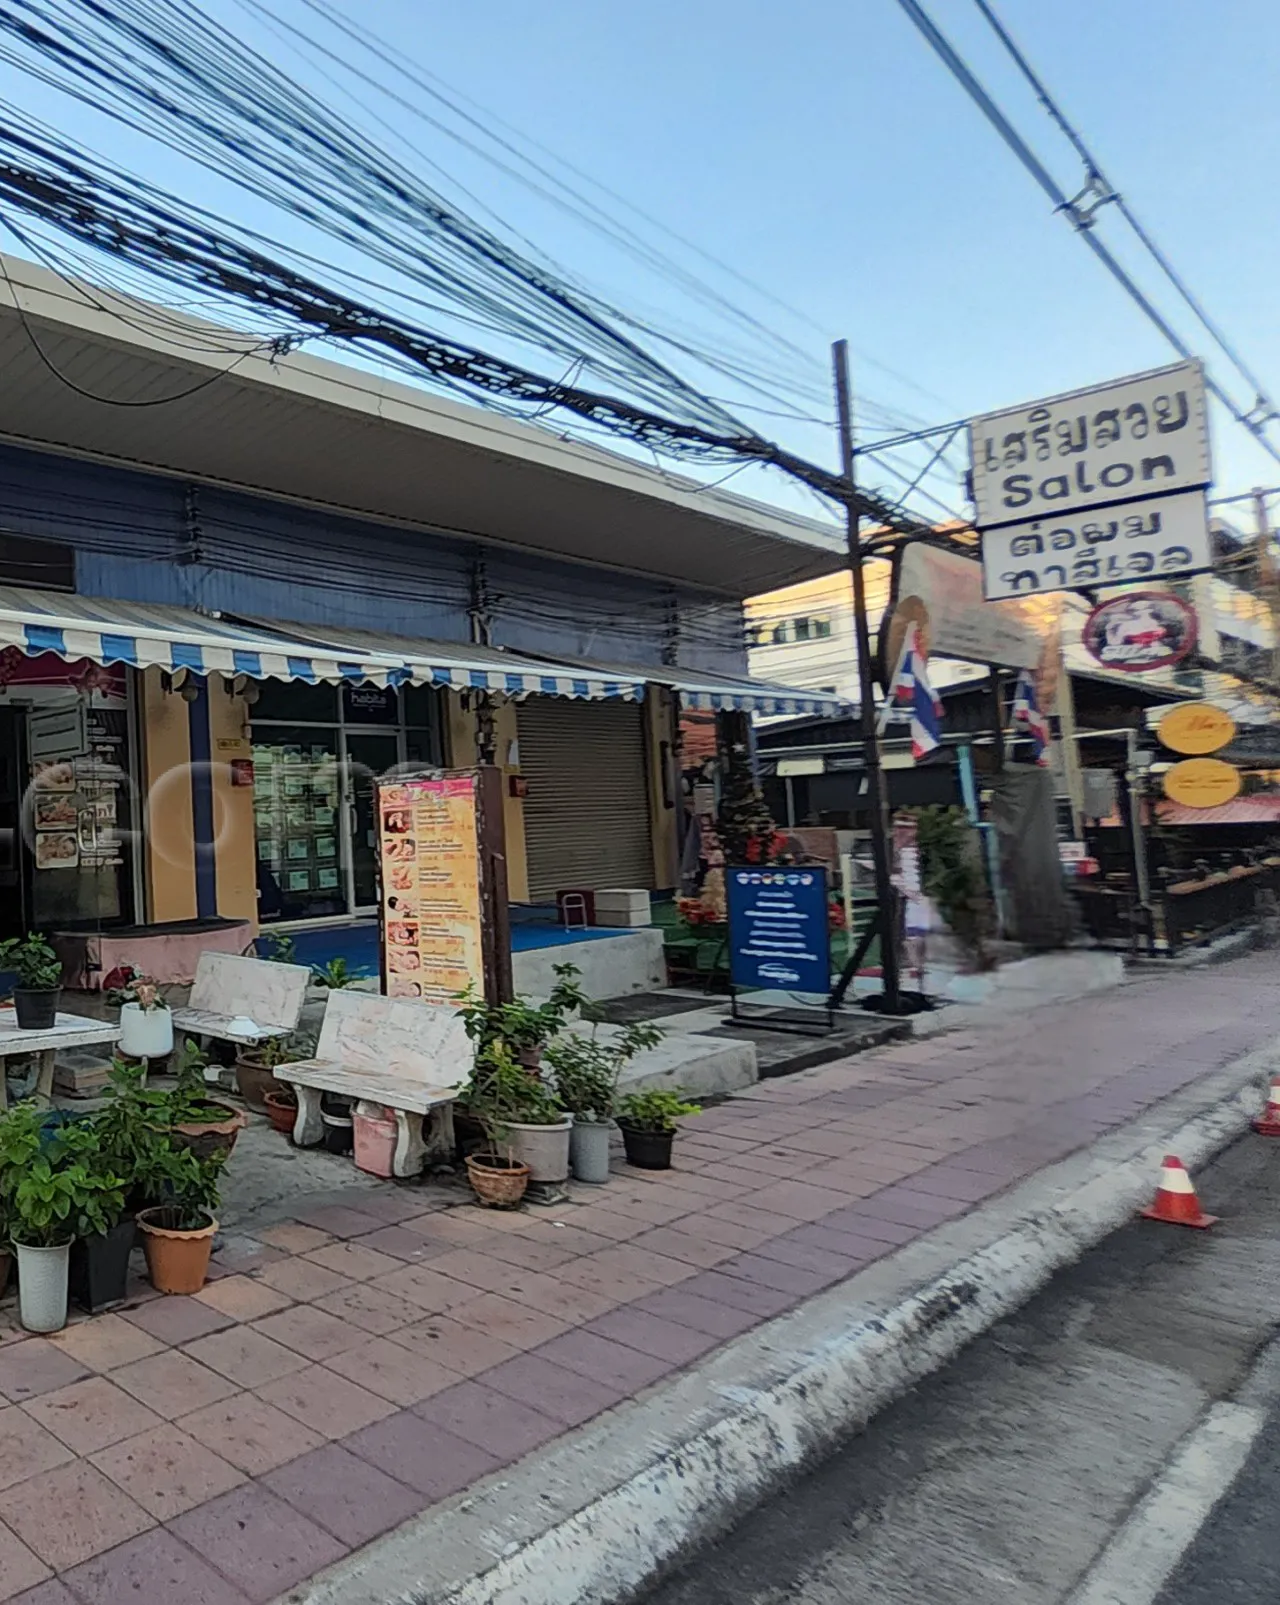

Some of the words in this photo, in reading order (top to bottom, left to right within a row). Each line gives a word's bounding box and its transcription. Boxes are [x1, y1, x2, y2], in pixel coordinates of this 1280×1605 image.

[984, 390, 1190, 473] เสริมสวย
[1002, 453, 1177, 508] Salon
[1009, 511, 1162, 558] ต่อผม
